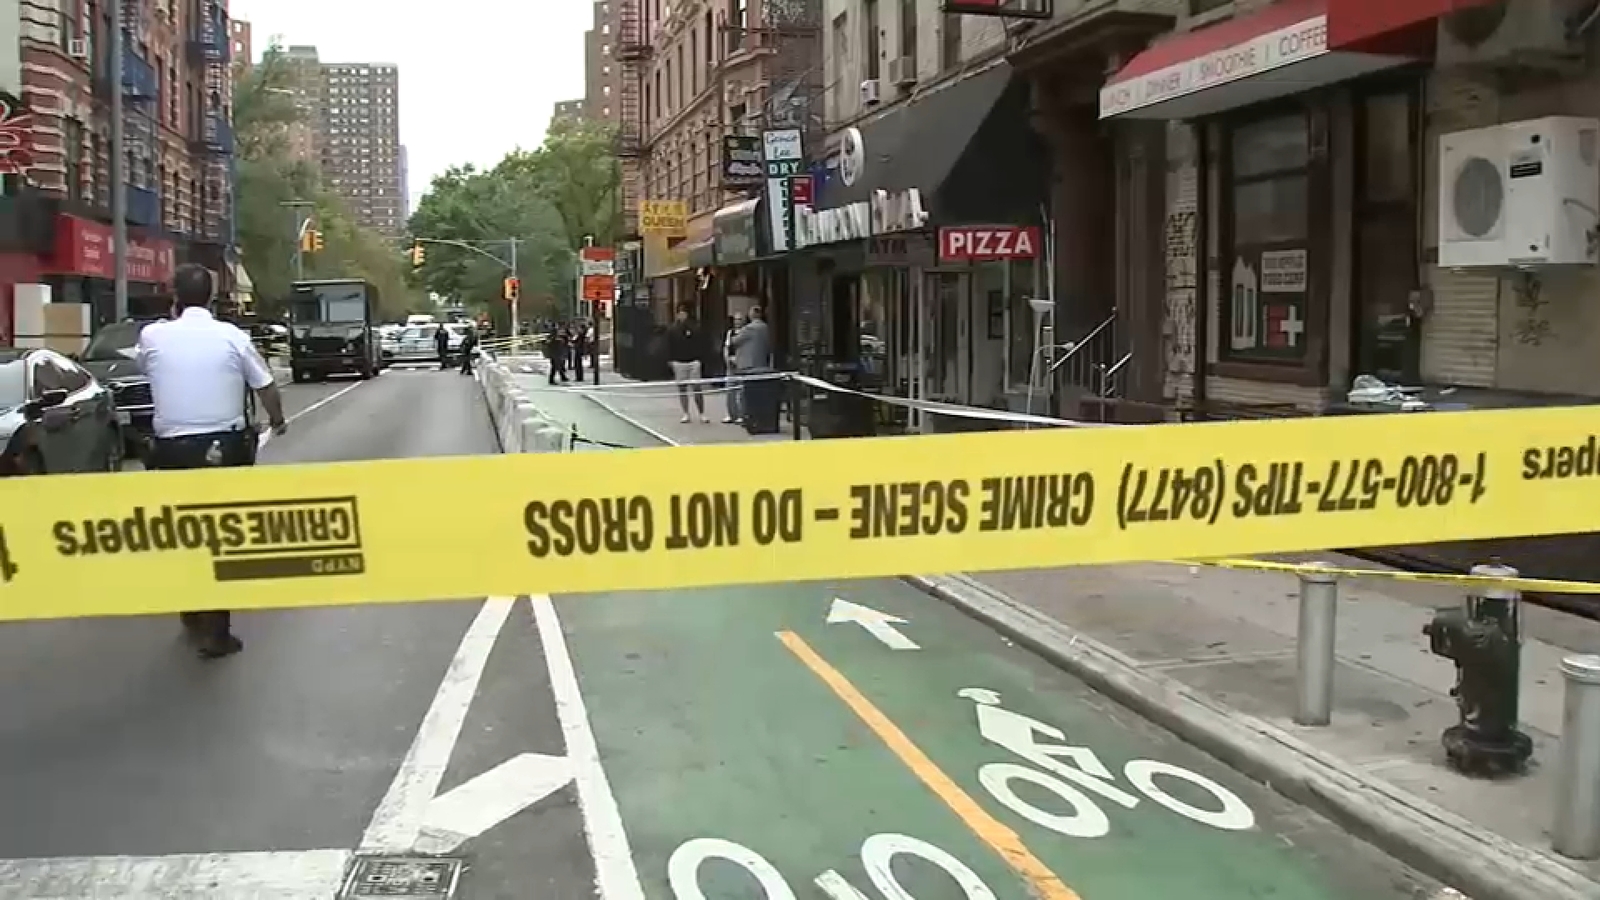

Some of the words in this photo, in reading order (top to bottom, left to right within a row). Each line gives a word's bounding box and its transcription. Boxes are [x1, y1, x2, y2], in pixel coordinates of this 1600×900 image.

[769, 162, 799, 175] DRY
[949, 231, 1033, 255] PIZZA
[849, 480, 970, 540] SCENE
[980, 472, 1094, 532] CRIME
[1117, 459, 1225, 530] (8477)
[1232, 453, 1486, 519] 1-800-577-TIPS
[524, 495, 654, 558] CROSS
[664, 492, 739, 550] NOT
[753, 488, 803, 546] DO
[311, 557, 361, 574] NYPD
